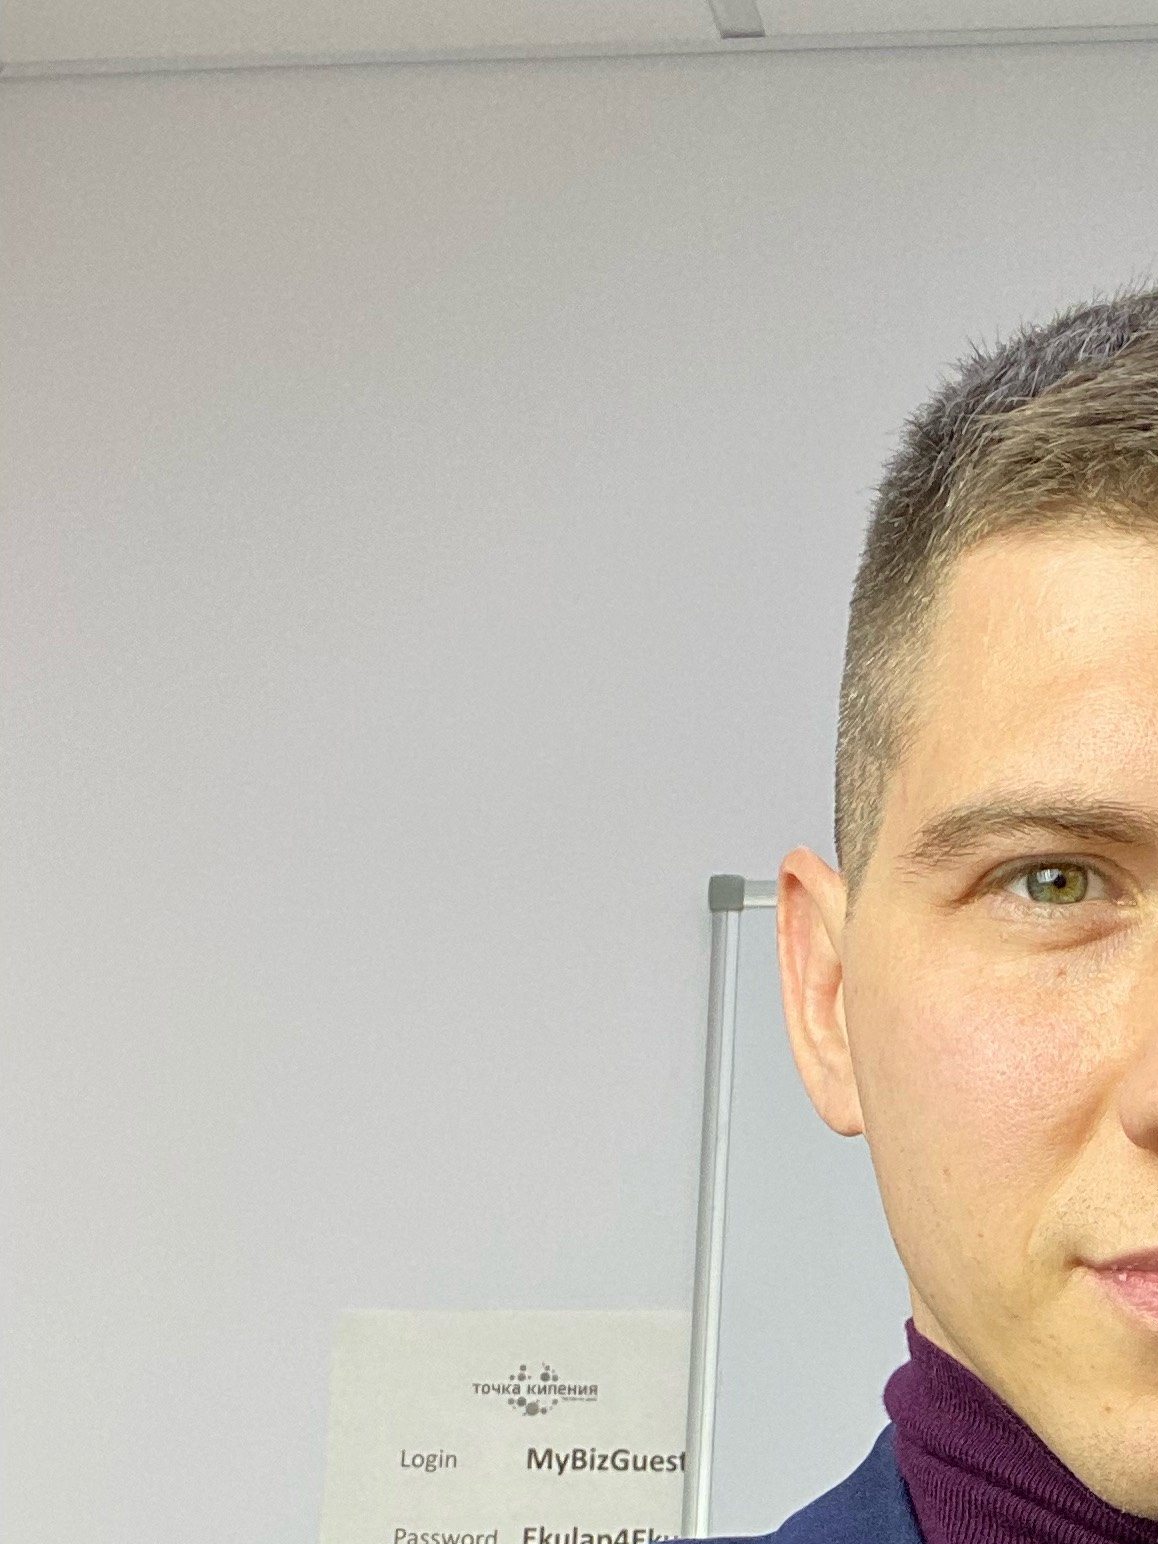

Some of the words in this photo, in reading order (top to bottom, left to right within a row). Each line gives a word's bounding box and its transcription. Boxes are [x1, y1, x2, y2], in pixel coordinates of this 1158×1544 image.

[472, 1383, 521, 1395] точка
[527, 1384, 598, 1396] кипения
[400, 1449, 457, 1472] Login
